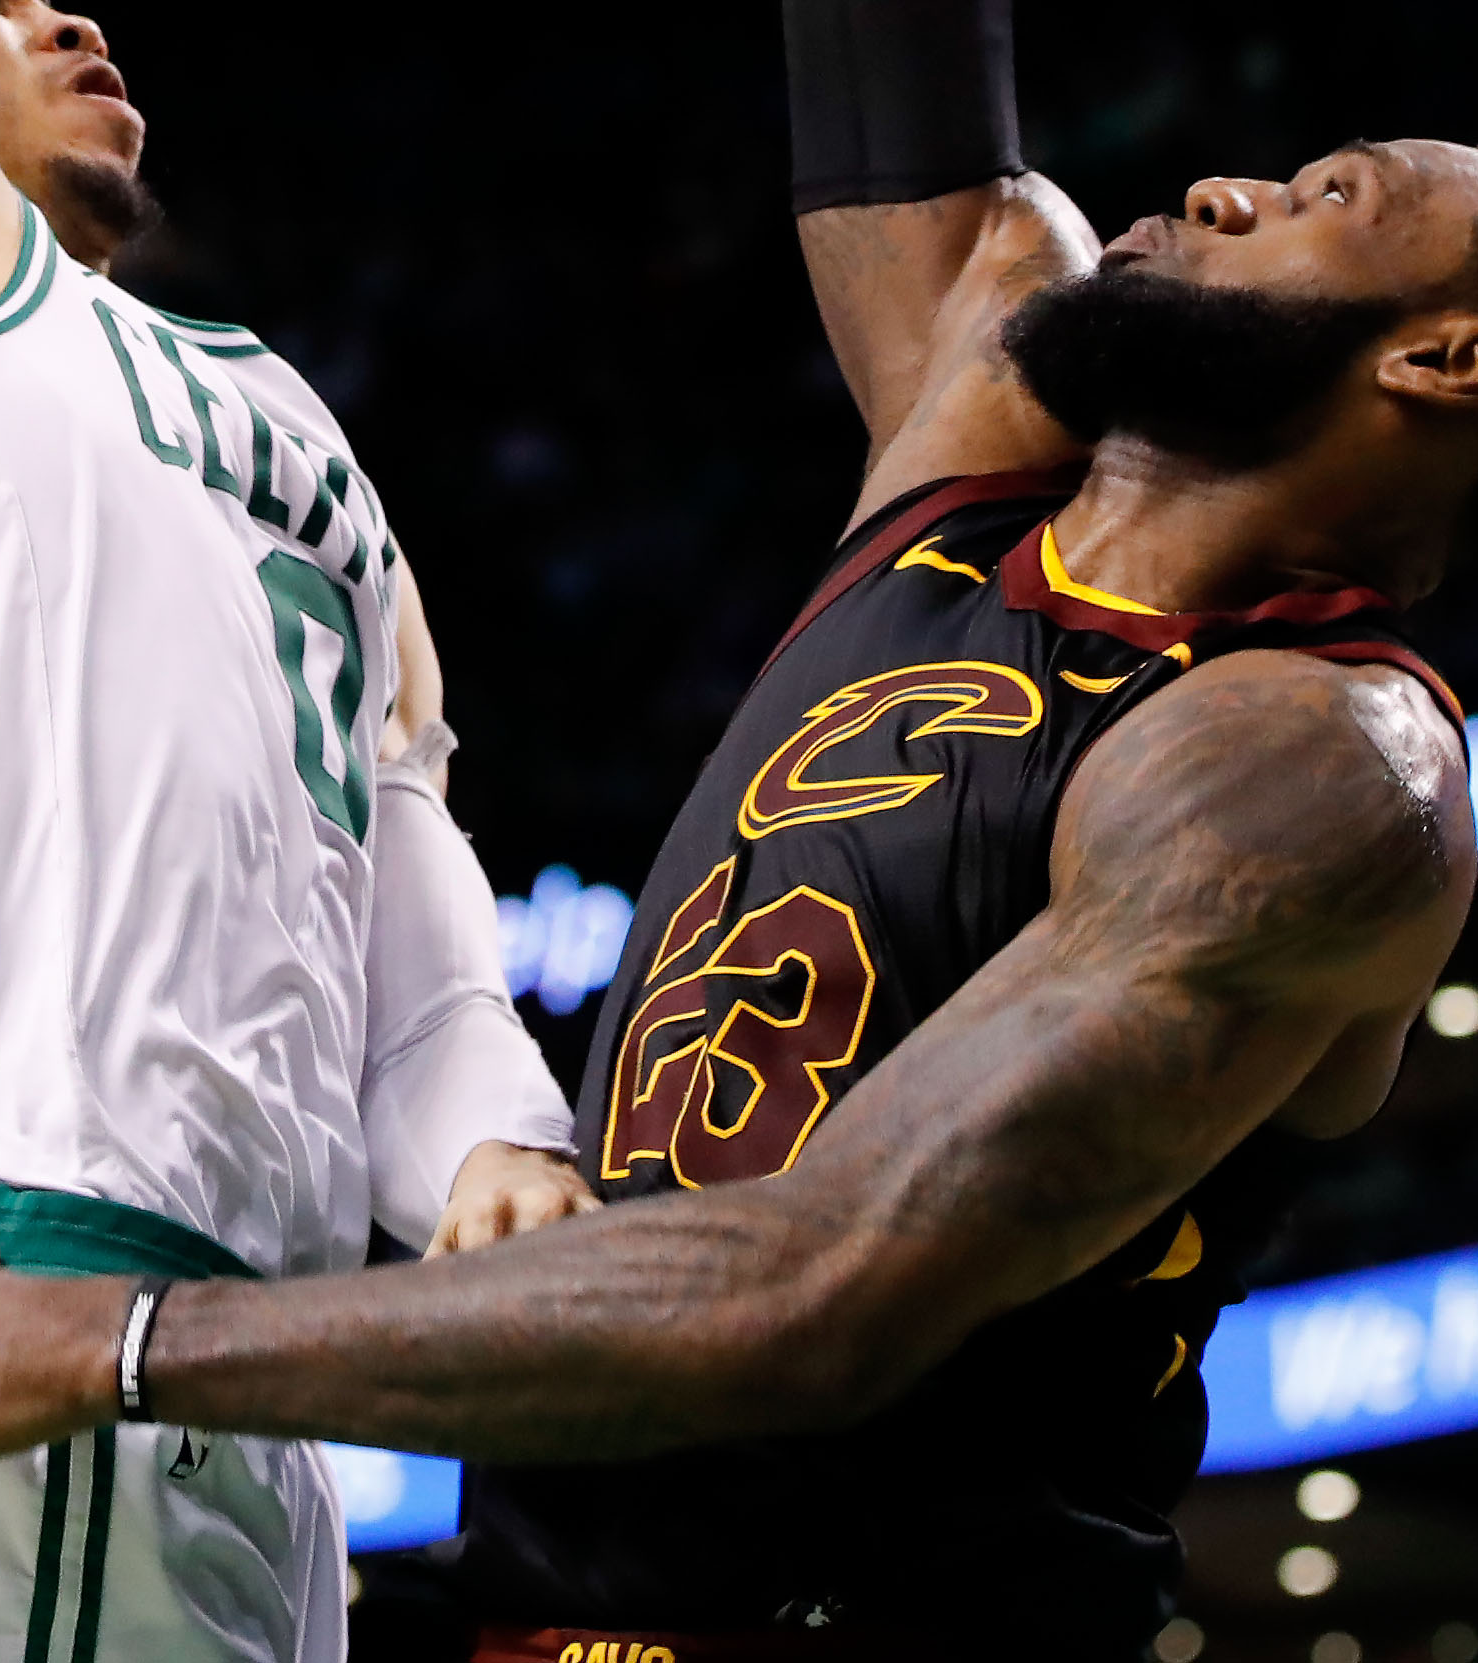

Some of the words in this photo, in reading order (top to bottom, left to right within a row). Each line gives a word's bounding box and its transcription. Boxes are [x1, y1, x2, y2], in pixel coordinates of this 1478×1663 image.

[258, 549, 370, 846] 0
[601, 855, 875, 1191] 23
[1269, 1291, 1426, 1431] We
